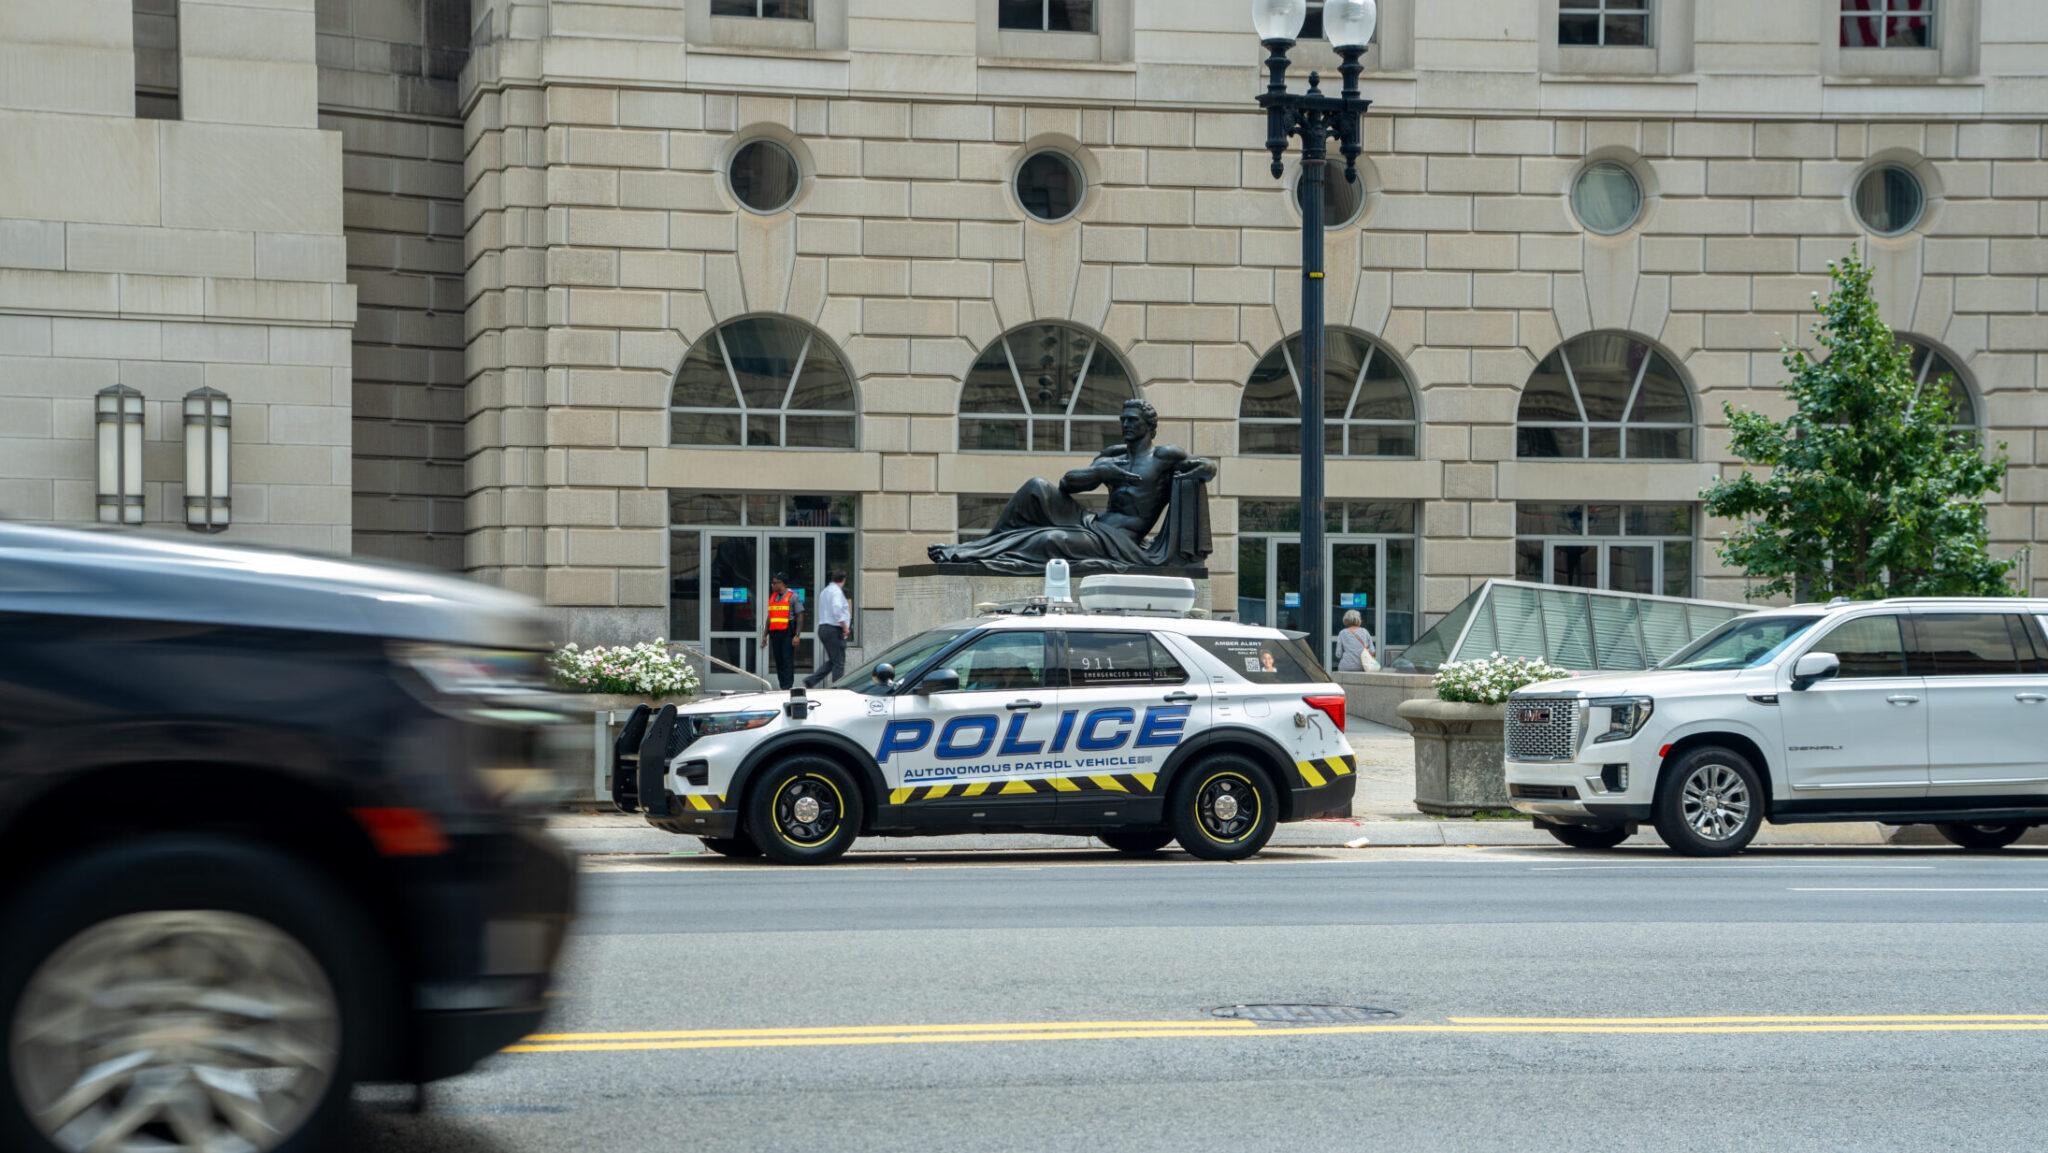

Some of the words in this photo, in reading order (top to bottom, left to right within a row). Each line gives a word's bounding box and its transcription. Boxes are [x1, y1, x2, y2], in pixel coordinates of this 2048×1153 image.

[1082, 657, 1115, 670] 911
[875, 704, 1192, 764] POLICE
[904, 763, 1012, 778] AUTONOMOUS
[1014, 759, 1072, 772] PATROL
[1076, 756, 1137, 768] VEHICLE
